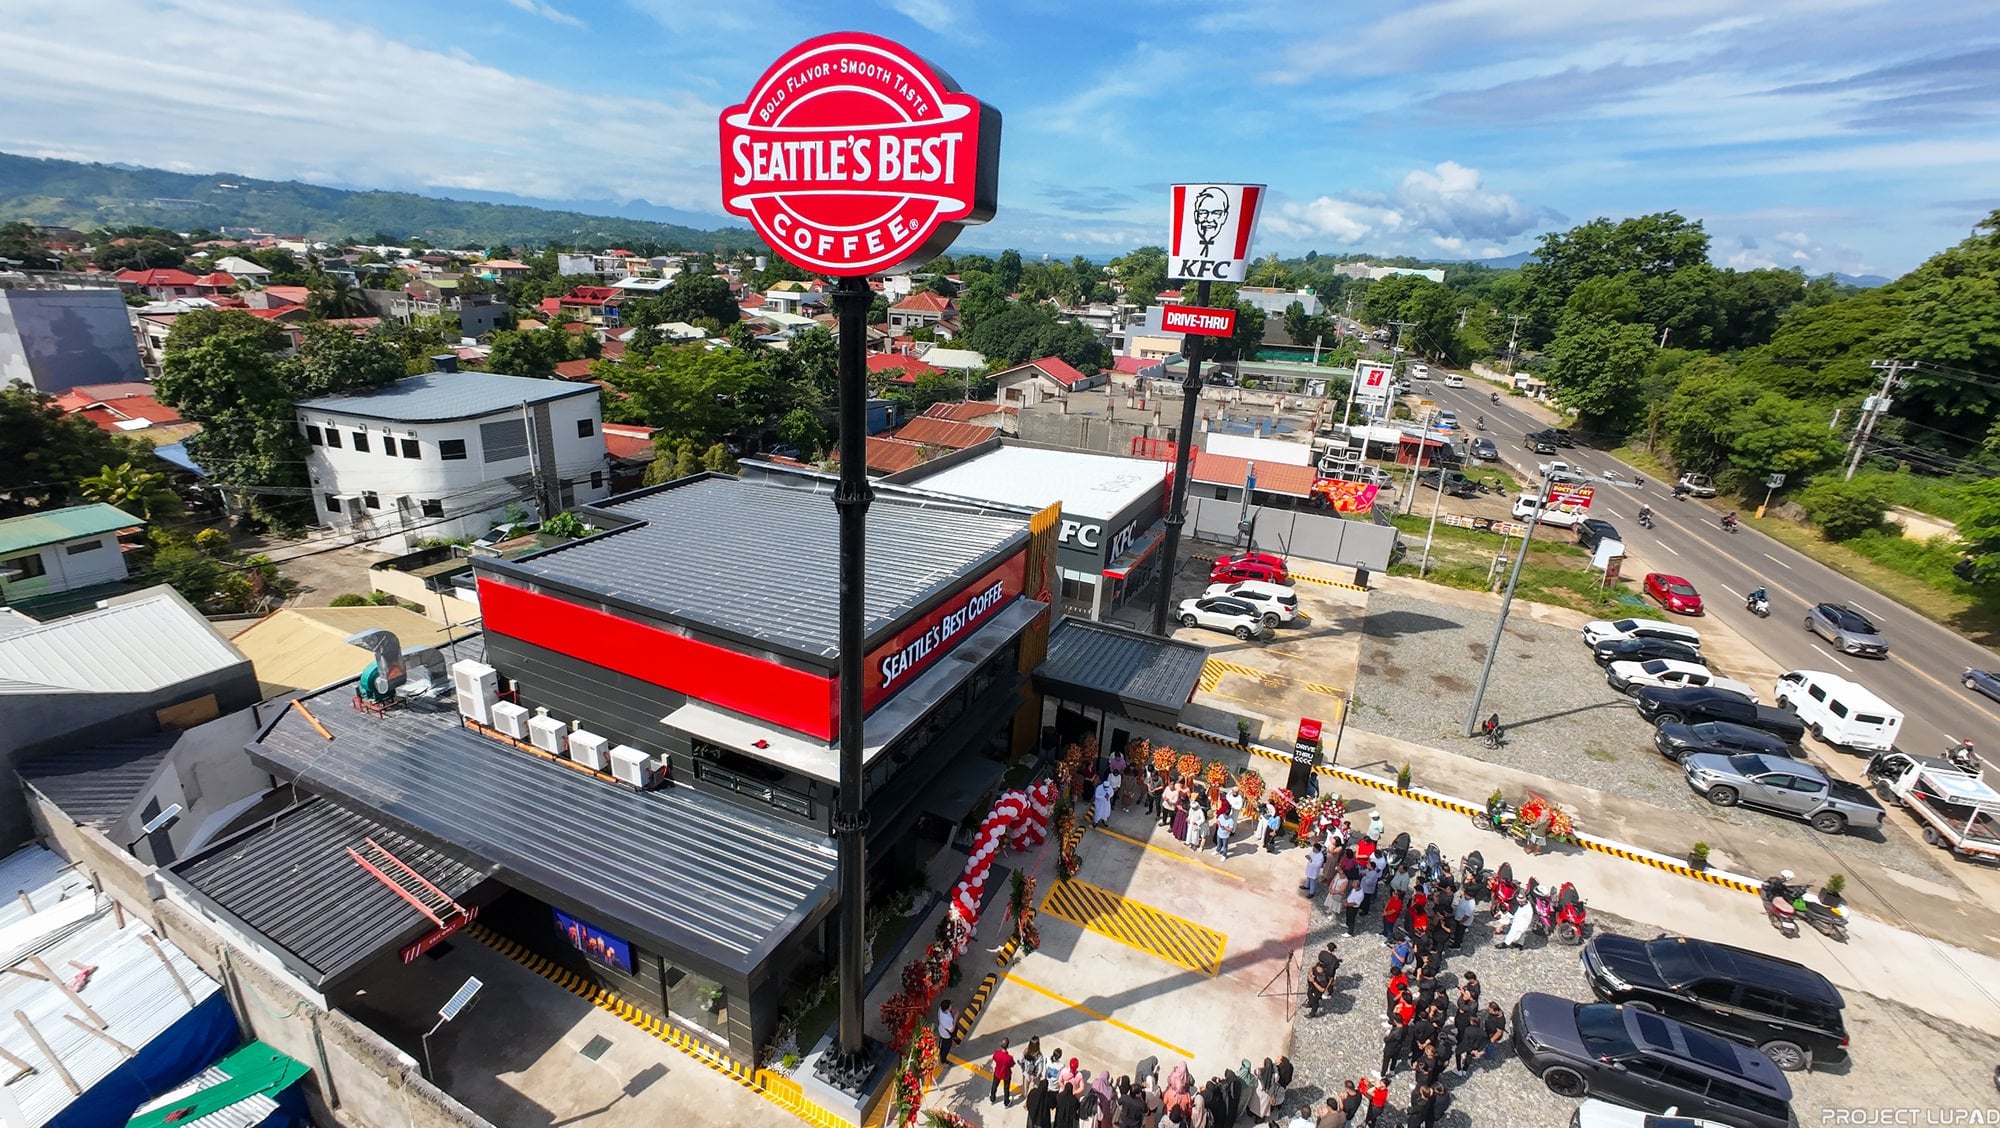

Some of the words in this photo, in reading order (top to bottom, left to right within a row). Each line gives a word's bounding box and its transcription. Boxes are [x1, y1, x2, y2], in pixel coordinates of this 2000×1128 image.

[759, 89, 786, 122] BOLD
[786, 62, 830, 93] FLAVOR
[840, 58, 891, 83] SMOOTH
[895, 74, 929, 117] TASTE
[733, 134, 872, 186] SEATTLE'S
[878, 132, 963, 185] BEST
[1178, 259, 1232, 279] KFC
[1167, 311, 1229, 330] DRIVE-THRU
[1058, 519, 1101, 548] FC
[1109, 520, 1137, 564] KFC
[882, 625, 941, 689] SEATTLE'S
[941, 605, 968, 642] BEST
[968, 580, 1004, 620] COFFEE
[1295, 742, 1317, 753] DRIVE
[1295, 749, 1314, 760] THRU
